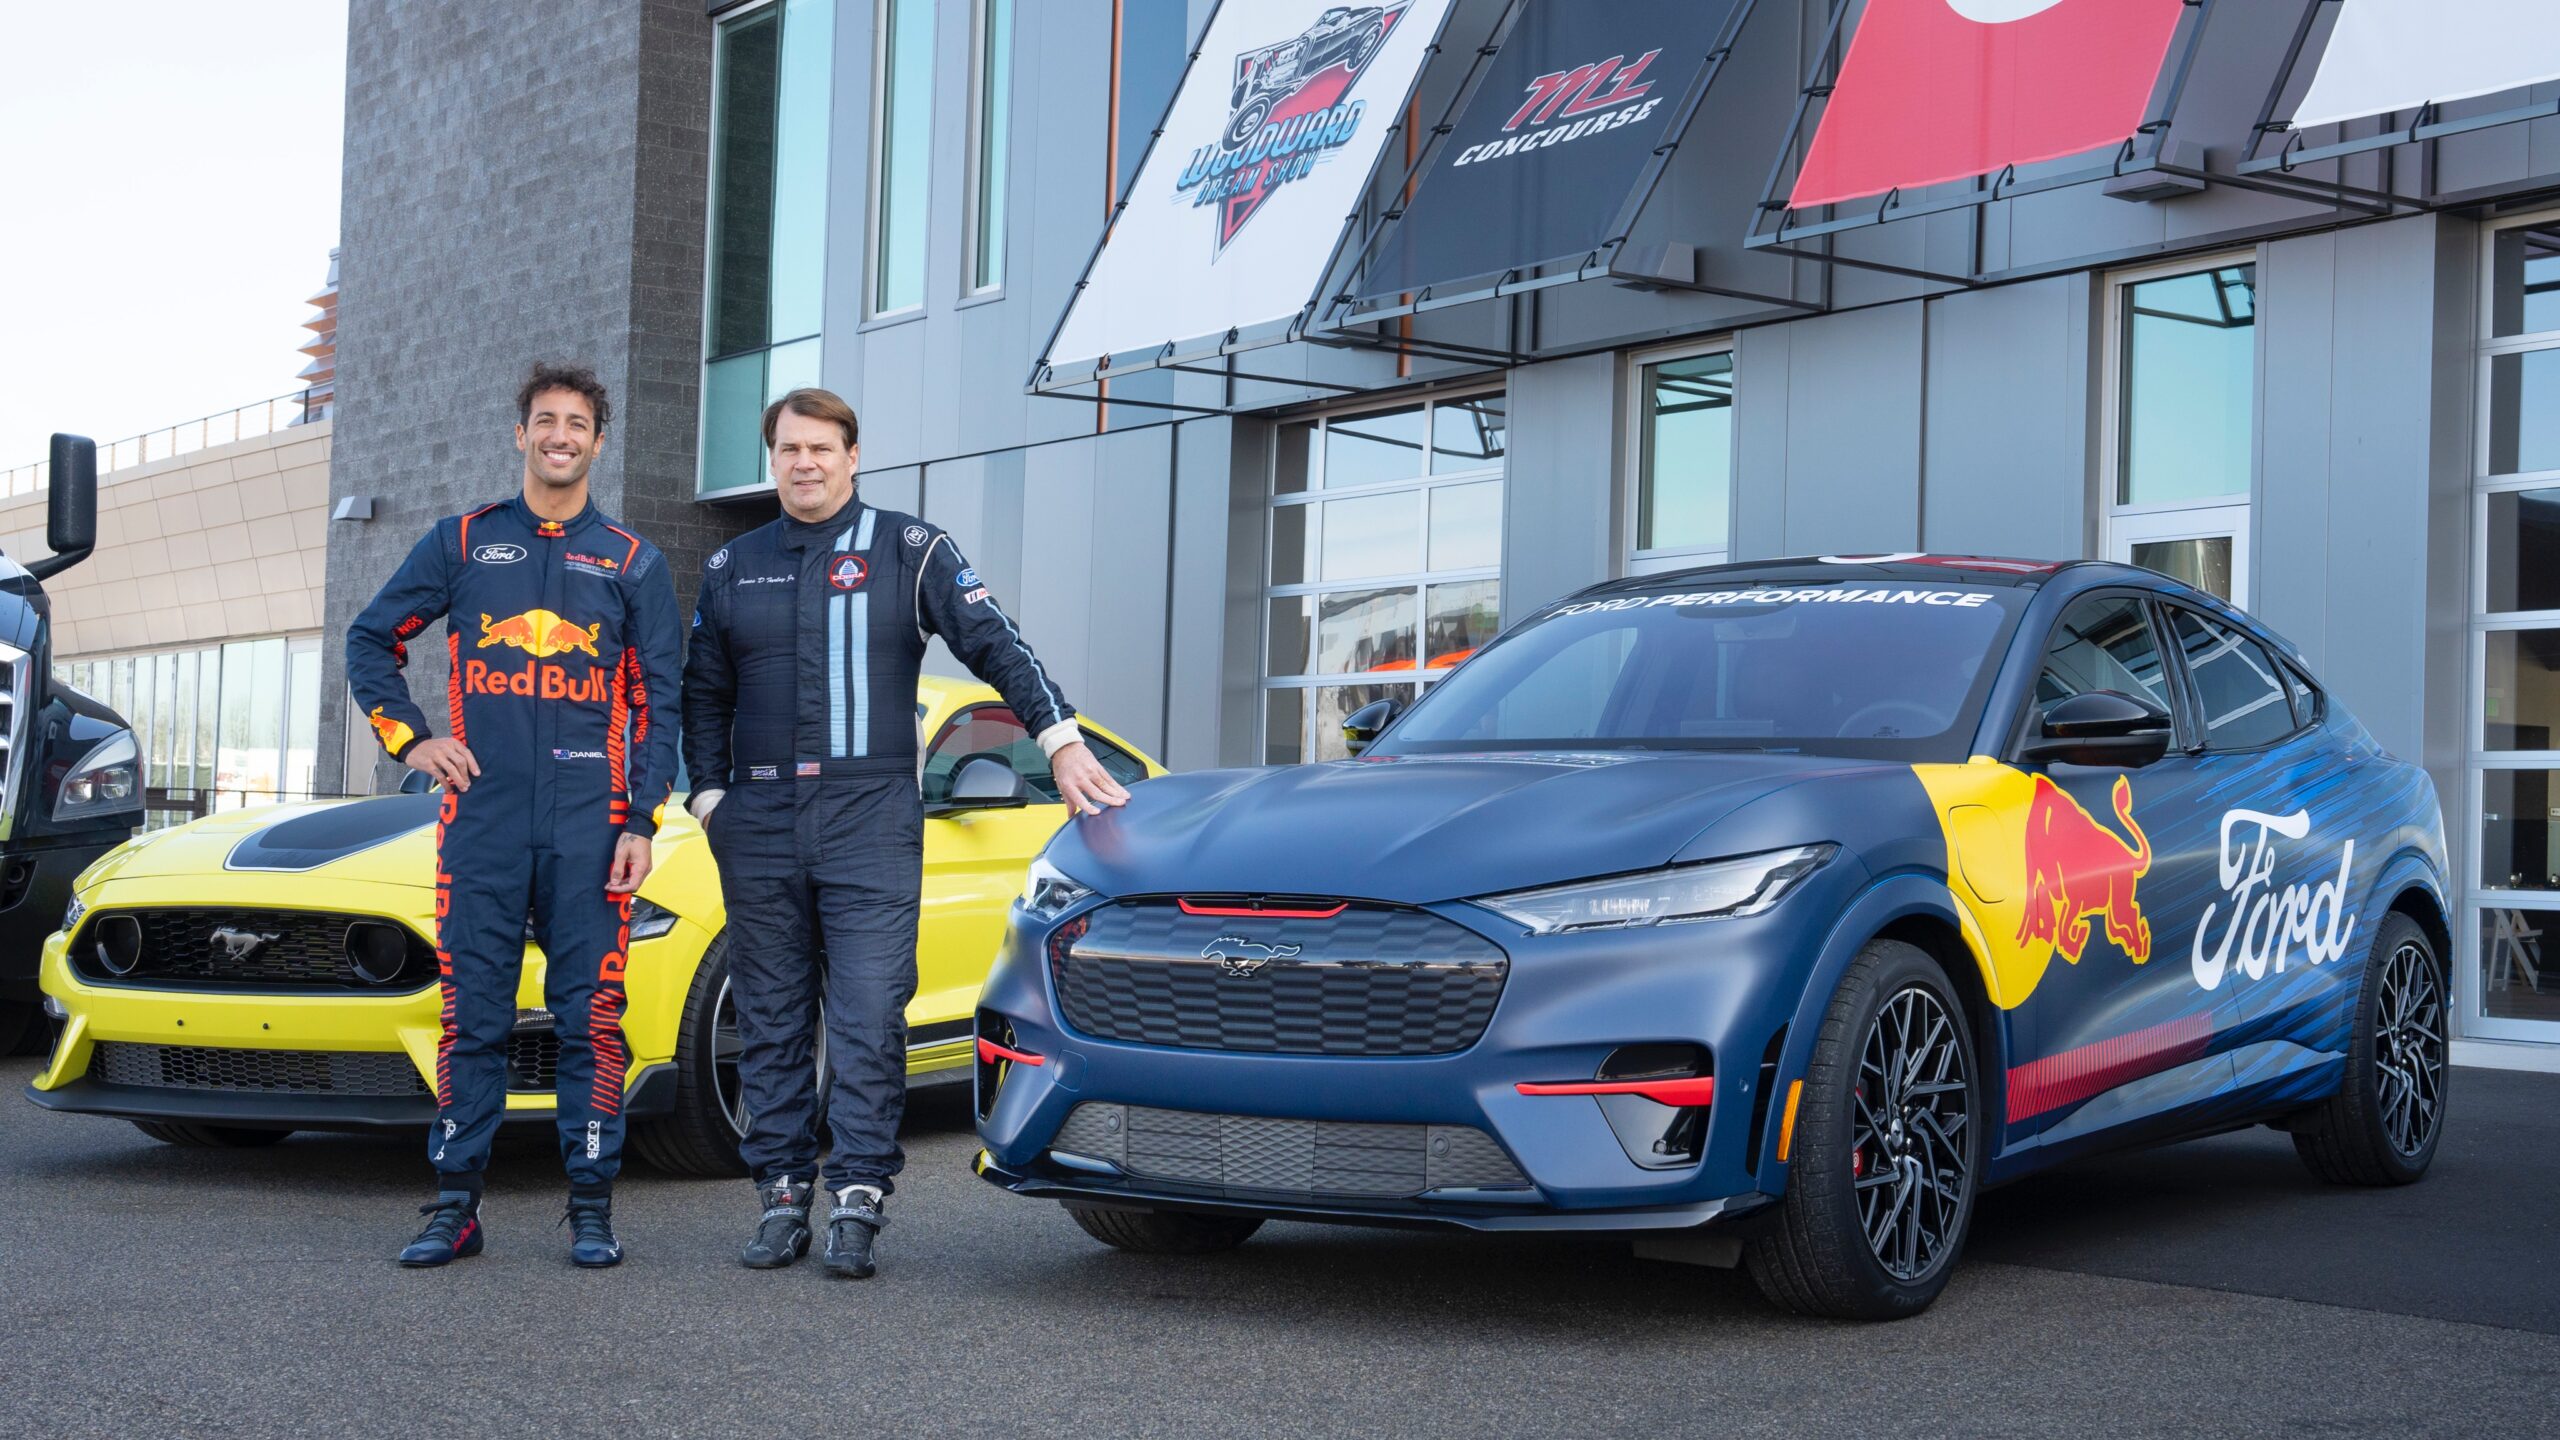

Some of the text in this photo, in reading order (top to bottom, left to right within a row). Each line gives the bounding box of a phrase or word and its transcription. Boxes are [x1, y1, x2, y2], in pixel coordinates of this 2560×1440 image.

[1501, 48, 1663, 132] M1
[1176, 99, 1367, 191] WOODWARD
[1453, 97, 1663, 167] CONCOURSE
[1194, 150, 1321, 207] DREAM SHOW
[482, 547, 516, 561] Ford
[565, 552, 597, 565] Red Bull
[832, 572, 865, 581] COBRA
[1543, 589, 1995, 621] FORD PERFORMANCE
[466, 660, 608, 702] Red Bull
[631, 681, 647, 706] YOU
[633, 705, 649, 743] WINGS
[570, 751, 607, 759] DANIEL
[2191, 808, 2356, 991] Ford
